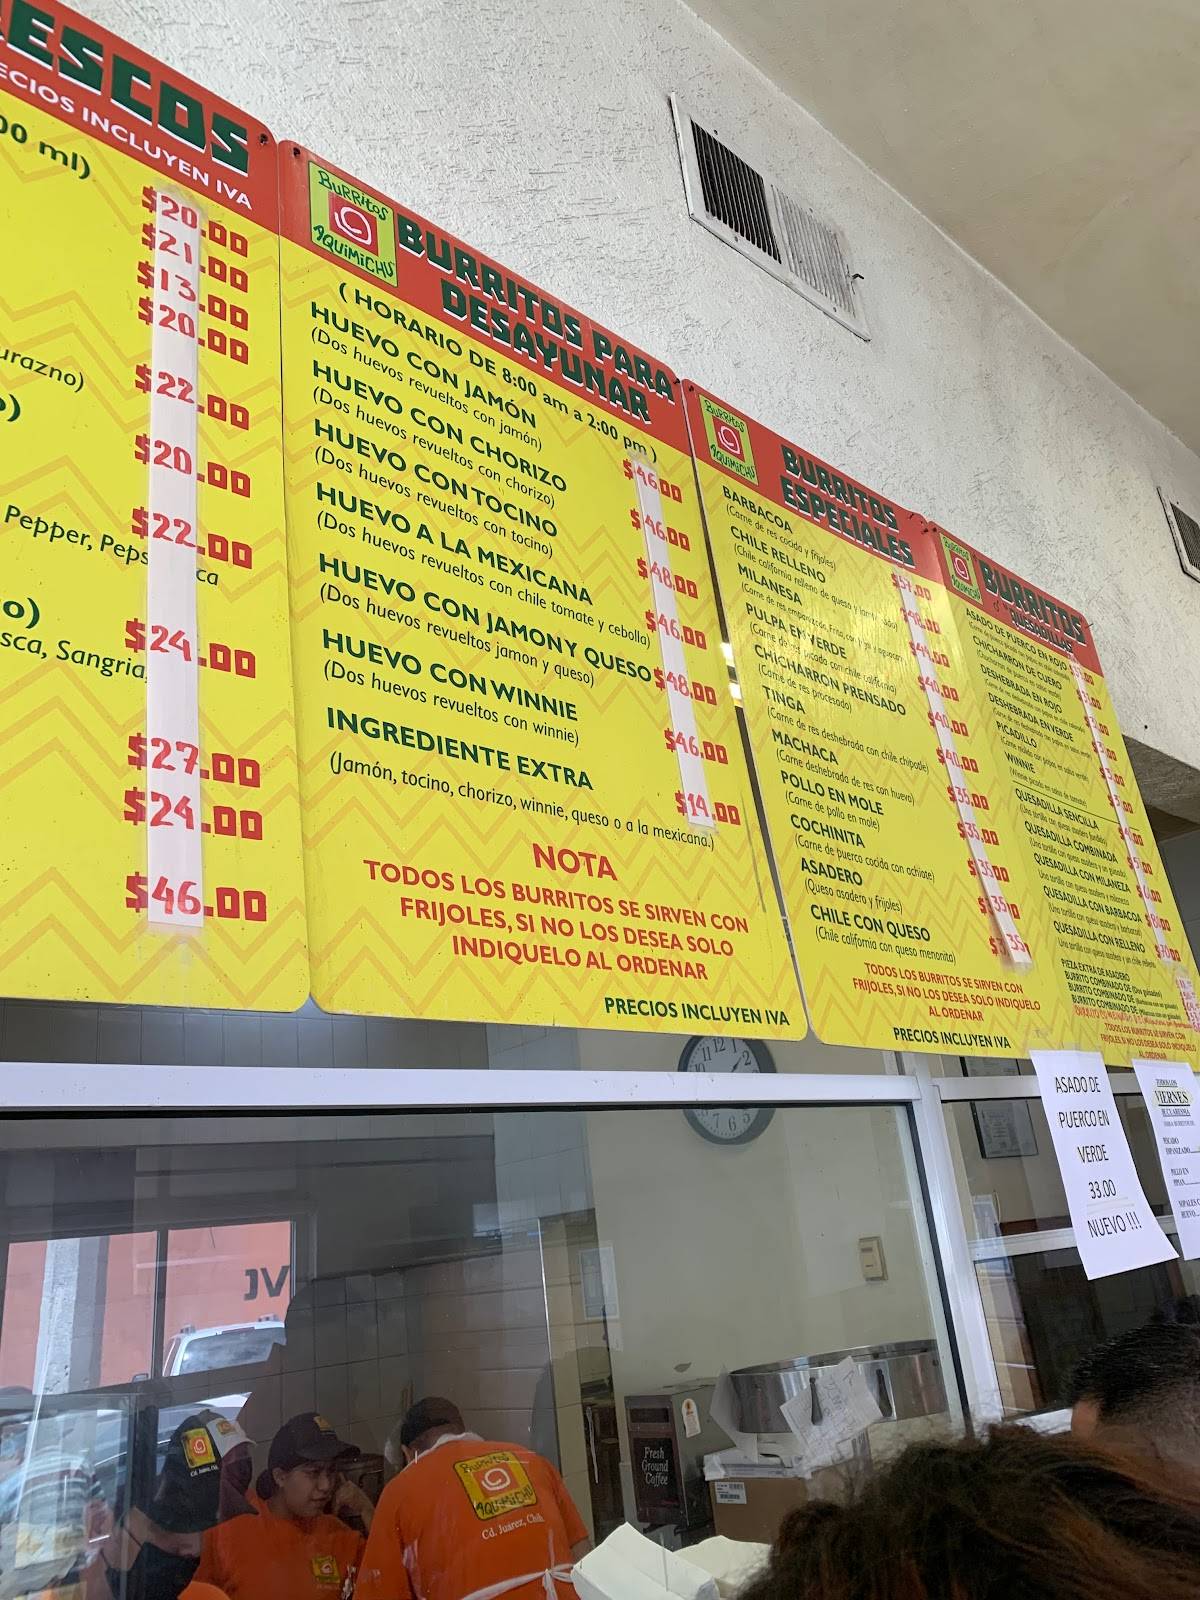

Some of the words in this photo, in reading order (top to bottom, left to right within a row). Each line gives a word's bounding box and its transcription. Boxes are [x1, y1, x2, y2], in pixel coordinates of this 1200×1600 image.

[0, 0, 249, 177] ESCOS
[39, 141, 90, 180] ml)
[82, 106, 209, 187] INCLUYEN
[216, 178, 252, 210] IVA
[142, 186, 248, 258] $20.00
[141, 223, 248, 293] $21.00
[137, 260, 249, 331] $13.00
[397, 213, 583, 351] BURRITOS
[592, 330, 675, 405] PARA
[137, 296, 249, 365] $20.00
[441, 279, 652, 425] DESAYUNAR
[311, 301, 400, 358] HUEVO
[407, 351, 459, 389] CON
[464, 379, 537, 429] JAMÓN
[355, 289, 462, 356] HORARIO
[469, 350, 497, 376] DE
[502, 368, 537, 397] 8:00
[543, 391, 568, 415] am
[588, 413, 618, 440] 2:00
[135, 364, 250, 431] $22.00
[311, 326, 348, 356] (Dos
[353, 346, 404, 382] huevos
[409, 376, 469, 414] revueltos
[473, 408, 496, 427] con
[499, 422, 543, 453] jamón)
[312, 359, 403, 415] HUEVO
[410, 408, 464, 445] CON
[470, 436, 567, 492] CHORIZO
[134, 433, 251, 498] $20.00
[314, 418, 407, 473] HUEVO
[414, 463, 469, 501] CON
[471, 487, 558, 538] TOCINO
[780, 444, 899, 534] BURRITOS
[505, 476, 555, 510] chorizo)
[723, 485, 793, 534] BARBACOA
[4, 504, 93, 551] Pepper,
[100, 534, 149, 565] Peps
[131, 506, 253, 570] $22.00
[316, 481, 411, 534] HUEVO
[440, 531, 472, 559] LA
[477, 546, 593, 606] MEXICANA
[511, 528, 553, 560] tocino)
[630, 508, 691, 552] $46.00
[780, 475, 916, 569] ESPECIALES
[636, 557, 699, 599] $48.00
[730, 525, 769, 555] CHILE
[771, 546, 826, 583] RELLENO
[738, 562, 802, 606] MILANESA
[979, 559, 1087, 647] BURRITOS
[319, 553, 416, 602] HUEVO
[423, 591, 480, 626] CON
[486, 612, 563, 654] JAMON
[584, 646, 652, 683] QUESO
[517, 588, 547, 609] chile
[551, 601, 594, 626] tomate
[608, 622, 651, 650] cebolla)
[645, 609, 707, 650] $46.00
[745, 602, 787, 633] PULPA
[124, 617, 256, 679] $24.00
[495, 642, 538, 668] jamon
[554, 661, 595, 689] queso)
[322, 628, 422, 675] HUEVO
[430, 663, 487, 696] CON
[490, 679, 578, 722] WINNIE
[653, 666, 718, 706] $48.00
[754, 644, 841, 692] CHICHARRON
[843, 683, 906, 716] PRENSADO
[762, 685, 806, 714] TINGA
[327, 706, 511, 773] INGREDIENTE
[517, 755, 594, 791] EXTRA
[533, 723, 580, 748] winnie)
[663, 727, 729, 765] $46.00
[771, 728, 839, 765] MACHACA
[996, 720, 1037, 748] PICADILLO
[127, 732, 261, 788] $27.00
[123, 786, 263, 841] $24.00
[330, 750, 397, 785] (Jamón,
[401, 768, 454, 798] tocino,
[458, 782, 516, 810] chorizo,
[520, 797, 568, 822] winnie,
[572, 808, 610, 830] queso
[653, 826, 715, 850] mexicana.)
[780, 770, 825, 797] POLLO
[849, 793, 884, 816] MOLE
[1015, 788, 1064, 816] QUESADILLA
[1064, 807, 1099, 831] SENCILLA
[790, 814, 866, 849] COCHINITA
[532, 842, 618, 881] NOTA
[801, 857, 863, 886] ASADERO
[125, 871, 267, 922] $46.00
[363, 858, 455, 892] TODOS
[460, 874, 506, 899] LOS
[512, 883, 614, 915] BURRITOS
[618, 899, 640, 918] SE
[645, 902, 706, 928] SIRVEN
[710, 912, 749, 934] CON
[400, 897, 513, 934] FRIJOLES,
[516, 912, 535, 933] SI
[541, 917, 574, 938] NO
[580, 921, 618, 941] LOS
[624, 927, 683, 951] DESEA
[687, 935, 733, 957] SOLO
[810, 904, 851, 927] CHILE
[853, 914, 885, 935] CON
[886, 921, 931, 942] QUESO
[452, 935, 581, 968] INDIQUELO
[586, 951, 612, 971] AL
[617, 953, 708, 981] ORDENAR
[604, 996, 677, 1019] PRECIOS
[681, 1003, 762, 1024] INCLUYEN
[765, 1009, 790, 1027] IVA
[742, 1050, 752, 1066] 2
[893, 1026, 940, 1044] PRECIOS
[940, 1031, 993, 1048] INCLUYEN
[994, 1035, 1012, 1049] IVA
[1055, 1076, 1088, 1093] ASADO
[1090, 1076, 1101, 1092] DE
[1155, 1090, 1189, 1104] VIERNES
[1058, 1110, 1096, 1129] PUERCO
[1099, 1110, 1110, 1127] EN
[1077, 1144, 1109, 1164] VERDE
[1088, 1179, 1117, 1200] 33.00
[1087, 1214, 1127, 1239] NUEVO
[641, 1459, 669, 1473] Ground
[644, 1446, 665, 1459] Fresh
[645, 1472, 669, 1488] Coffee
[481, 1527, 497, 1540] Cd.
